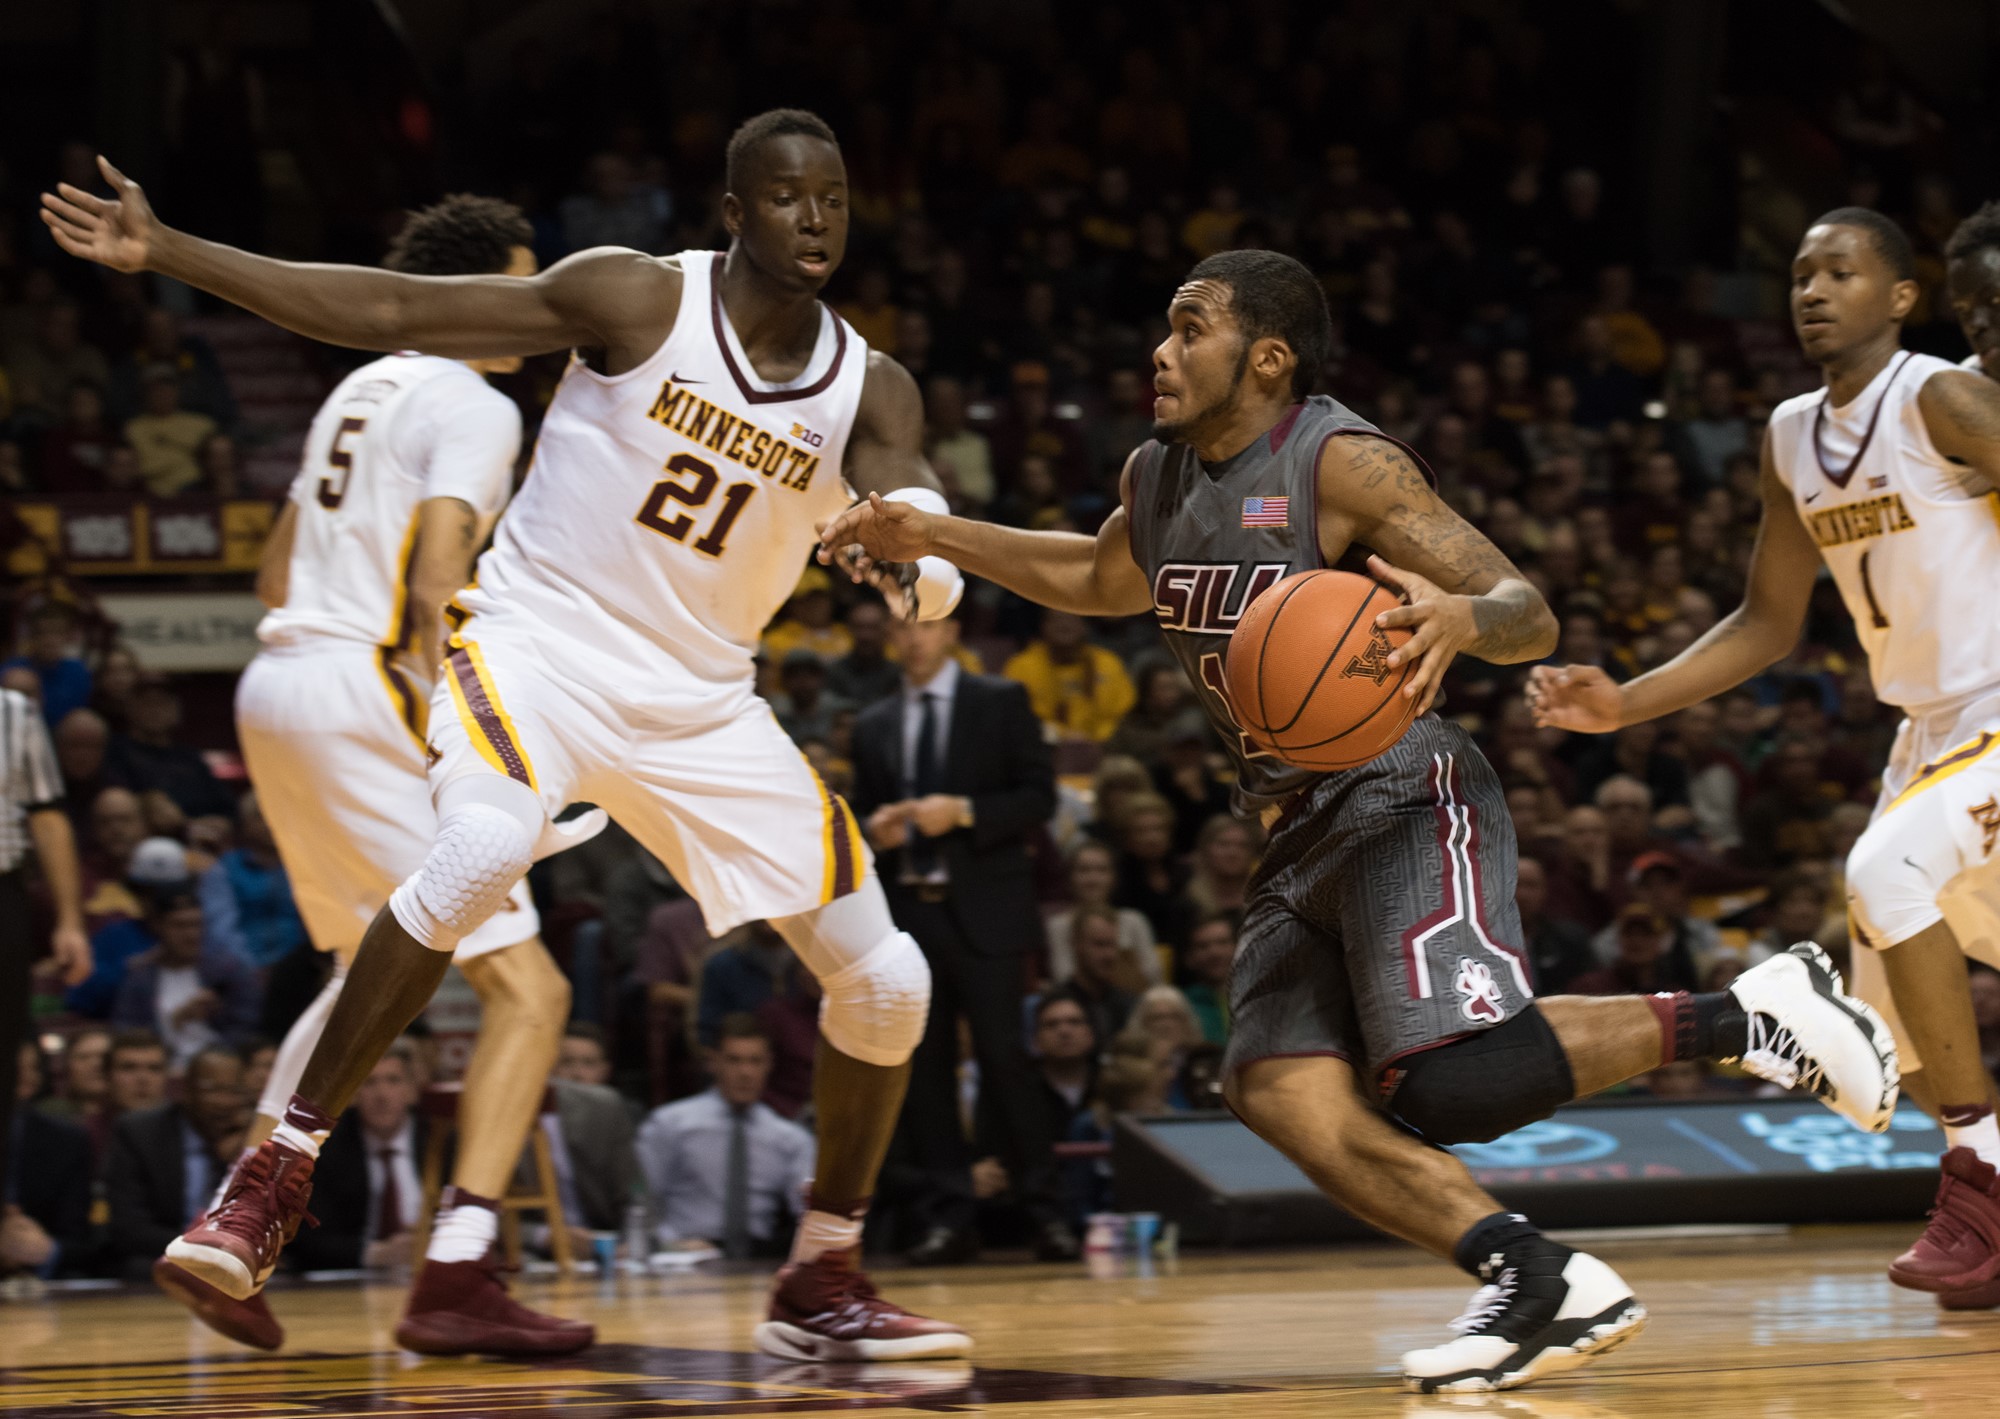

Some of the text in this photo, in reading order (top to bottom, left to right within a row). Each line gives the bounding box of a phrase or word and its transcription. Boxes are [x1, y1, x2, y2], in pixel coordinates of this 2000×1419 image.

[316, 416, 368, 512] 5
[645, 379, 820, 492] MINNESOTA
[632, 452, 757, 558] 21
[1154, 561, 1292, 637] SIU
[1859, 550, 1891, 629] 1
